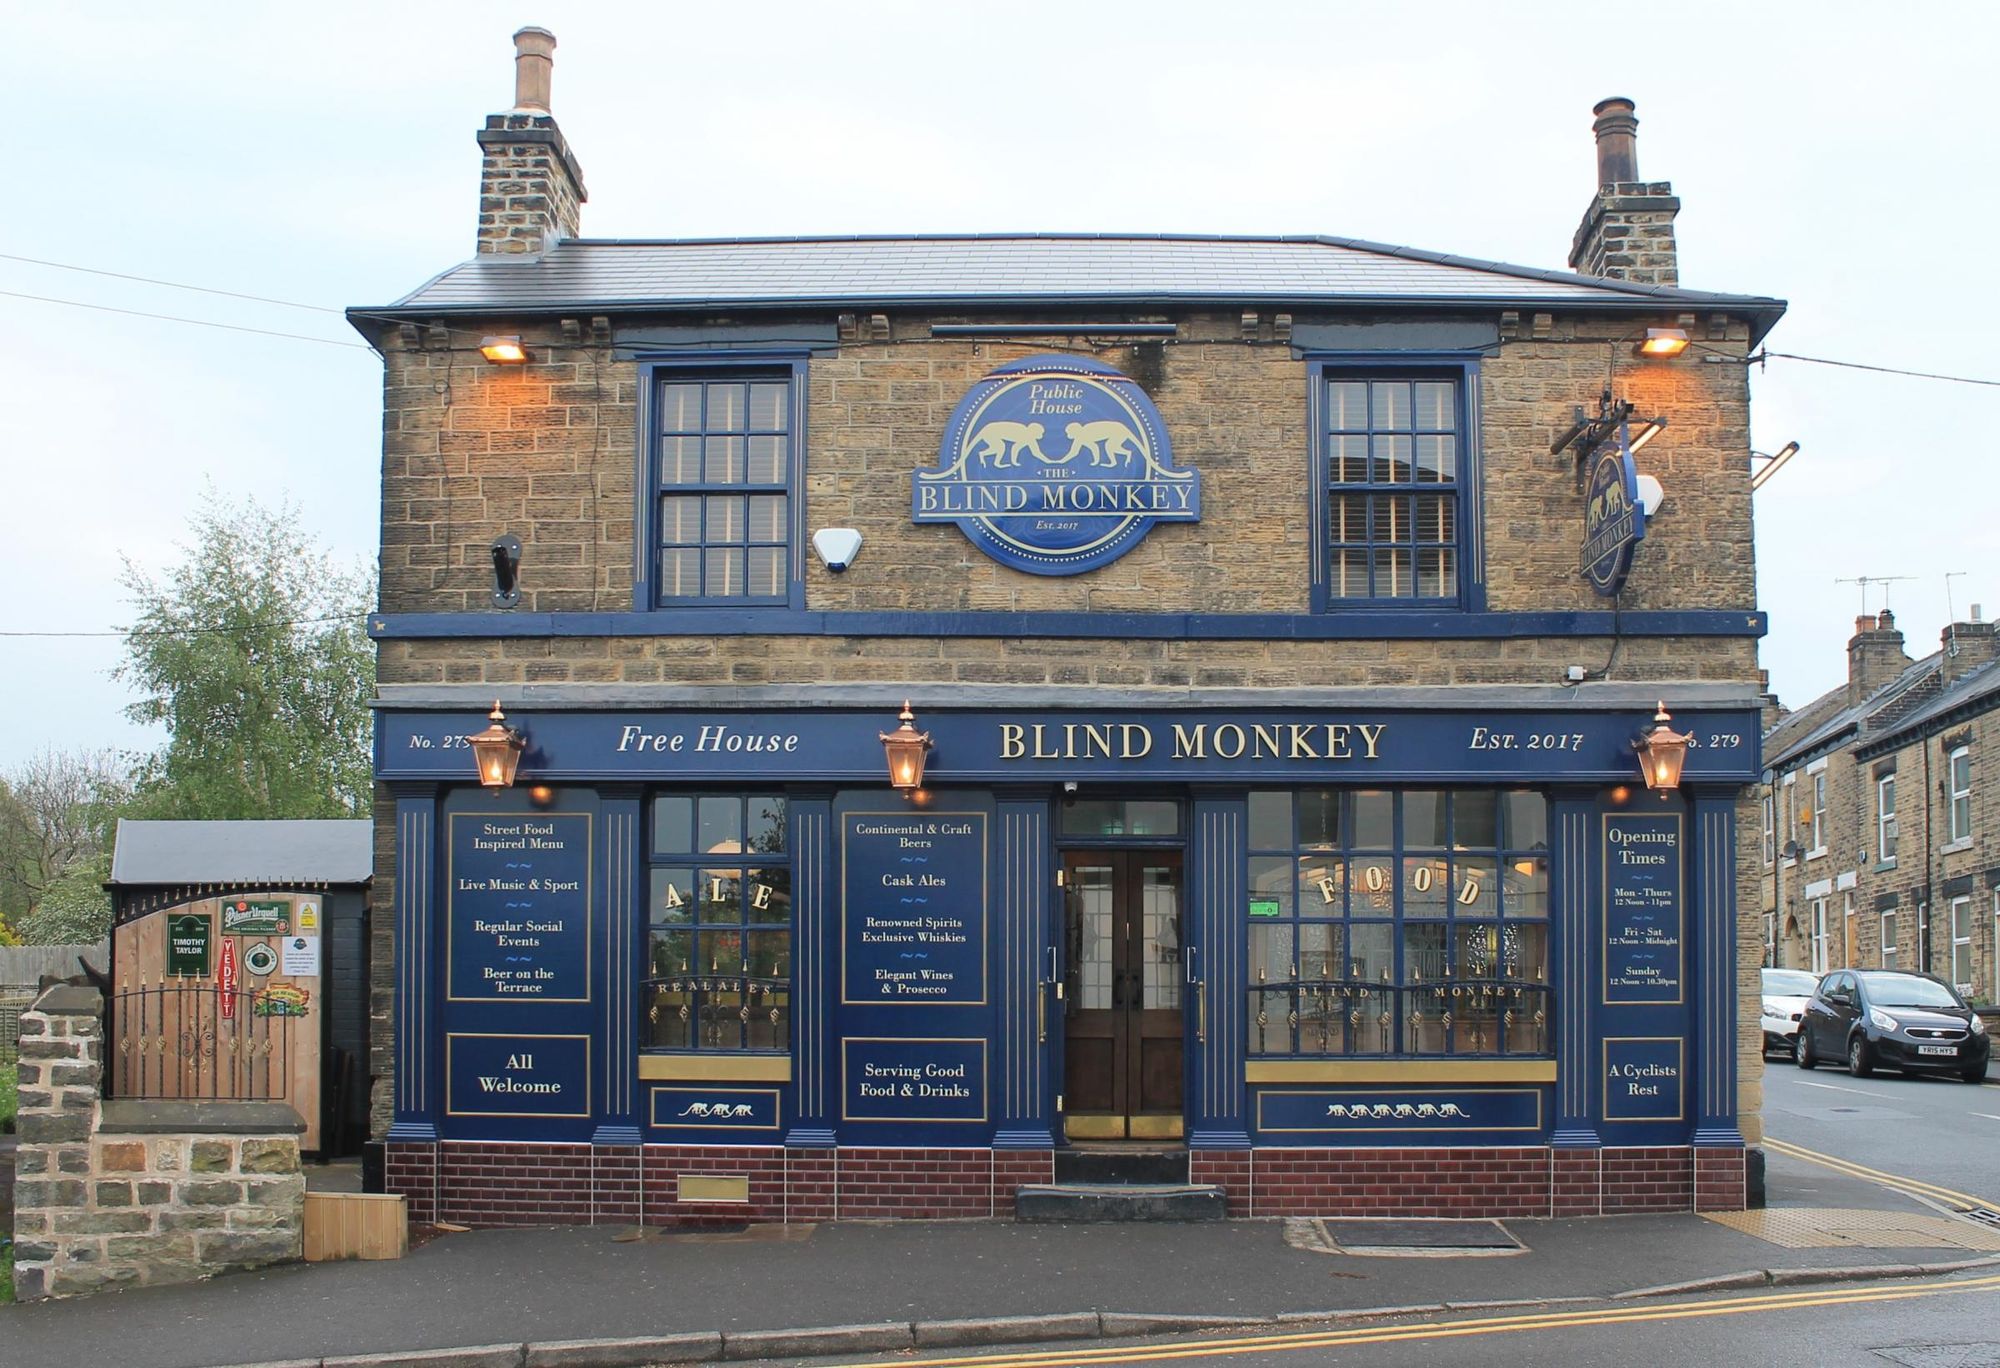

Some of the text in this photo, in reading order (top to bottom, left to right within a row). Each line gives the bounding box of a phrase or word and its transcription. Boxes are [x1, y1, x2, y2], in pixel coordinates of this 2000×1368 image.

[1029, 384, 1083, 400] Public
[1031, 401, 1082, 414] House
[1044, 468, 1069, 477] THE
[919, 484, 1194, 511] BLIND MONKEY
[1057, 522, 1079, 530] 2017
[409, 735, 435, 748] No.
[617, 724, 798, 752] Free House
[1000, 724, 1386, 759] BLIND MONKEY
[1527, 734, 1584, 751] 2017
[1710, 734, 1740, 748] 279
[484, 824, 553, 835] Street Food
[856, 824, 971, 835] Continental & Craft
[899, 838, 931, 848] Beers
[1609, 828, 1675, 846] Opening
[474, 838, 564, 851] Inspired Menu
[1619, 850, 1666, 865] Times
[460, 879, 579, 893] Live Music & Sport
[882, 874, 946, 886] Cask Ales
[1318, 866, 1480, 905] FOOD
[665, 878, 773, 910] ALE
[1615, 888, 1635, 897] Mon
[1643, 888, 1672, 897] Thurs
[1651, 899, 1671, 907] 11pm
[475, 921, 563, 933] Regular Social
[866, 917, 962, 929] Renowned Spirits
[862, 932, 966, 942] Exclusive Whiskies
[1625, 927, 1638, 936] Fri
[1647, 927, 1662, 936] Sat
[498, 936, 540, 946] Events
[1645, 937, 1677, 946] Midnight
[484, 968, 554, 979] Beer on the
[875, 970, 953, 982] Elegant Wines
[1626, 966, 1661, 977] Sunday
[223, 942, 232, 1015] VEDETT
[495, 982, 542, 992] Terrace
[881, 983, 947, 994] & Prosecco
[1299, 986, 1522, 998] BLIND MONKEY
[506, 1054, 533, 1069] All
[865, 1064, 964, 1080] Serving Good
[1608, 1064, 1676, 1079] A Cyclists
[479, 1078, 561, 1093] Welcome
[860, 1083, 970, 1097] Food & Drinks
[1628, 1083, 1658, 1095] Rest
